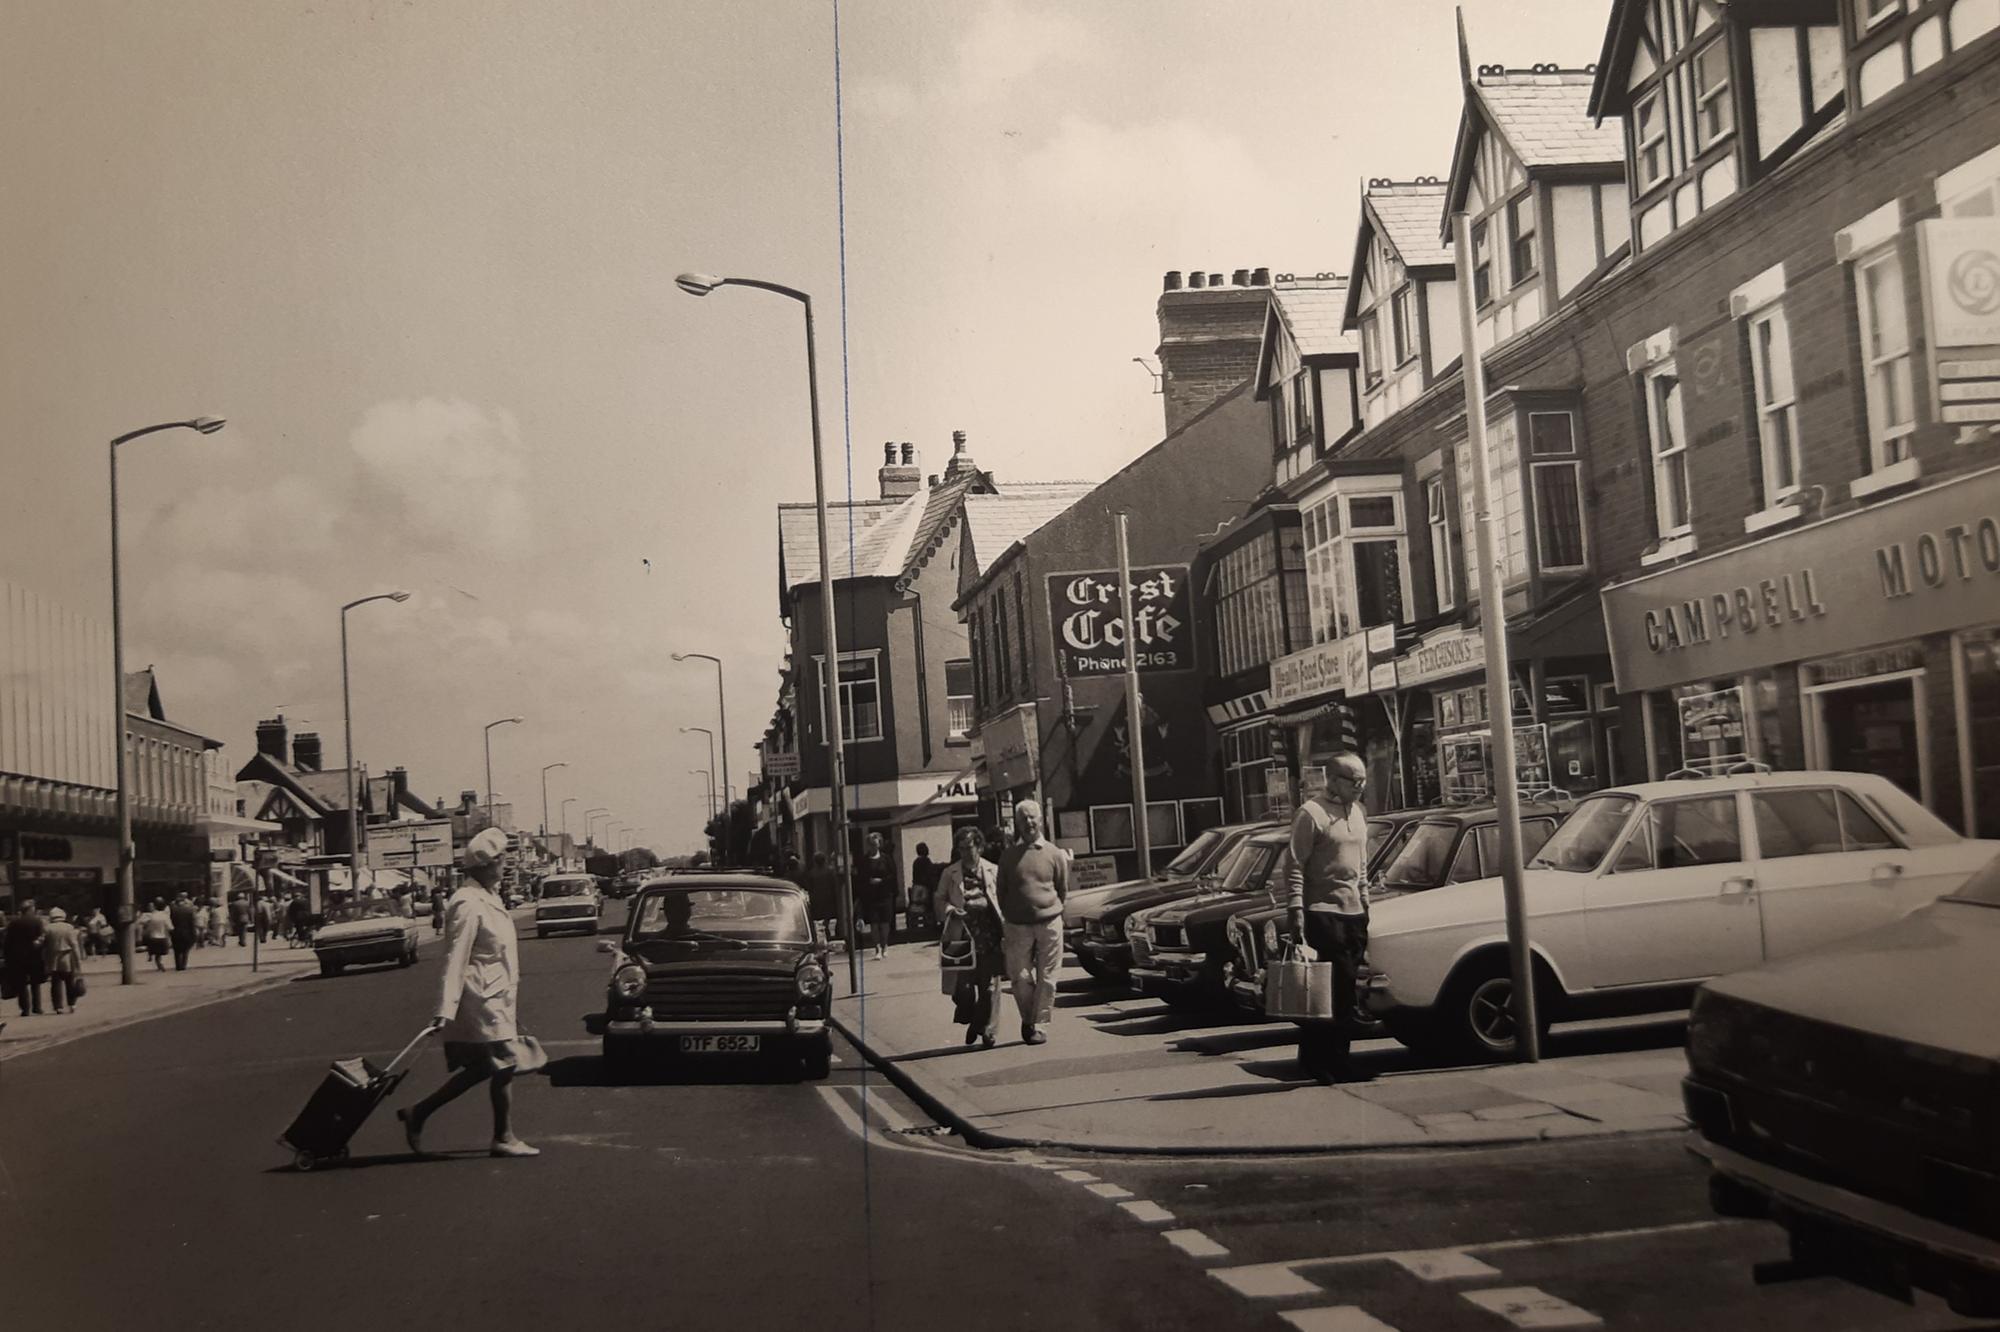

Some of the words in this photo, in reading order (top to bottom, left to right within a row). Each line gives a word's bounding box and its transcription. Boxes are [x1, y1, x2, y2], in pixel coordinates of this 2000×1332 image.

[1644, 568, 1826, 654] CAMPBELL
[1062, 605, 1181, 650] Café
[1136, 652, 1177, 667] 2163
[682, 1036, 712, 1051] DTF
[717, 1036, 759, 1051] 652J
